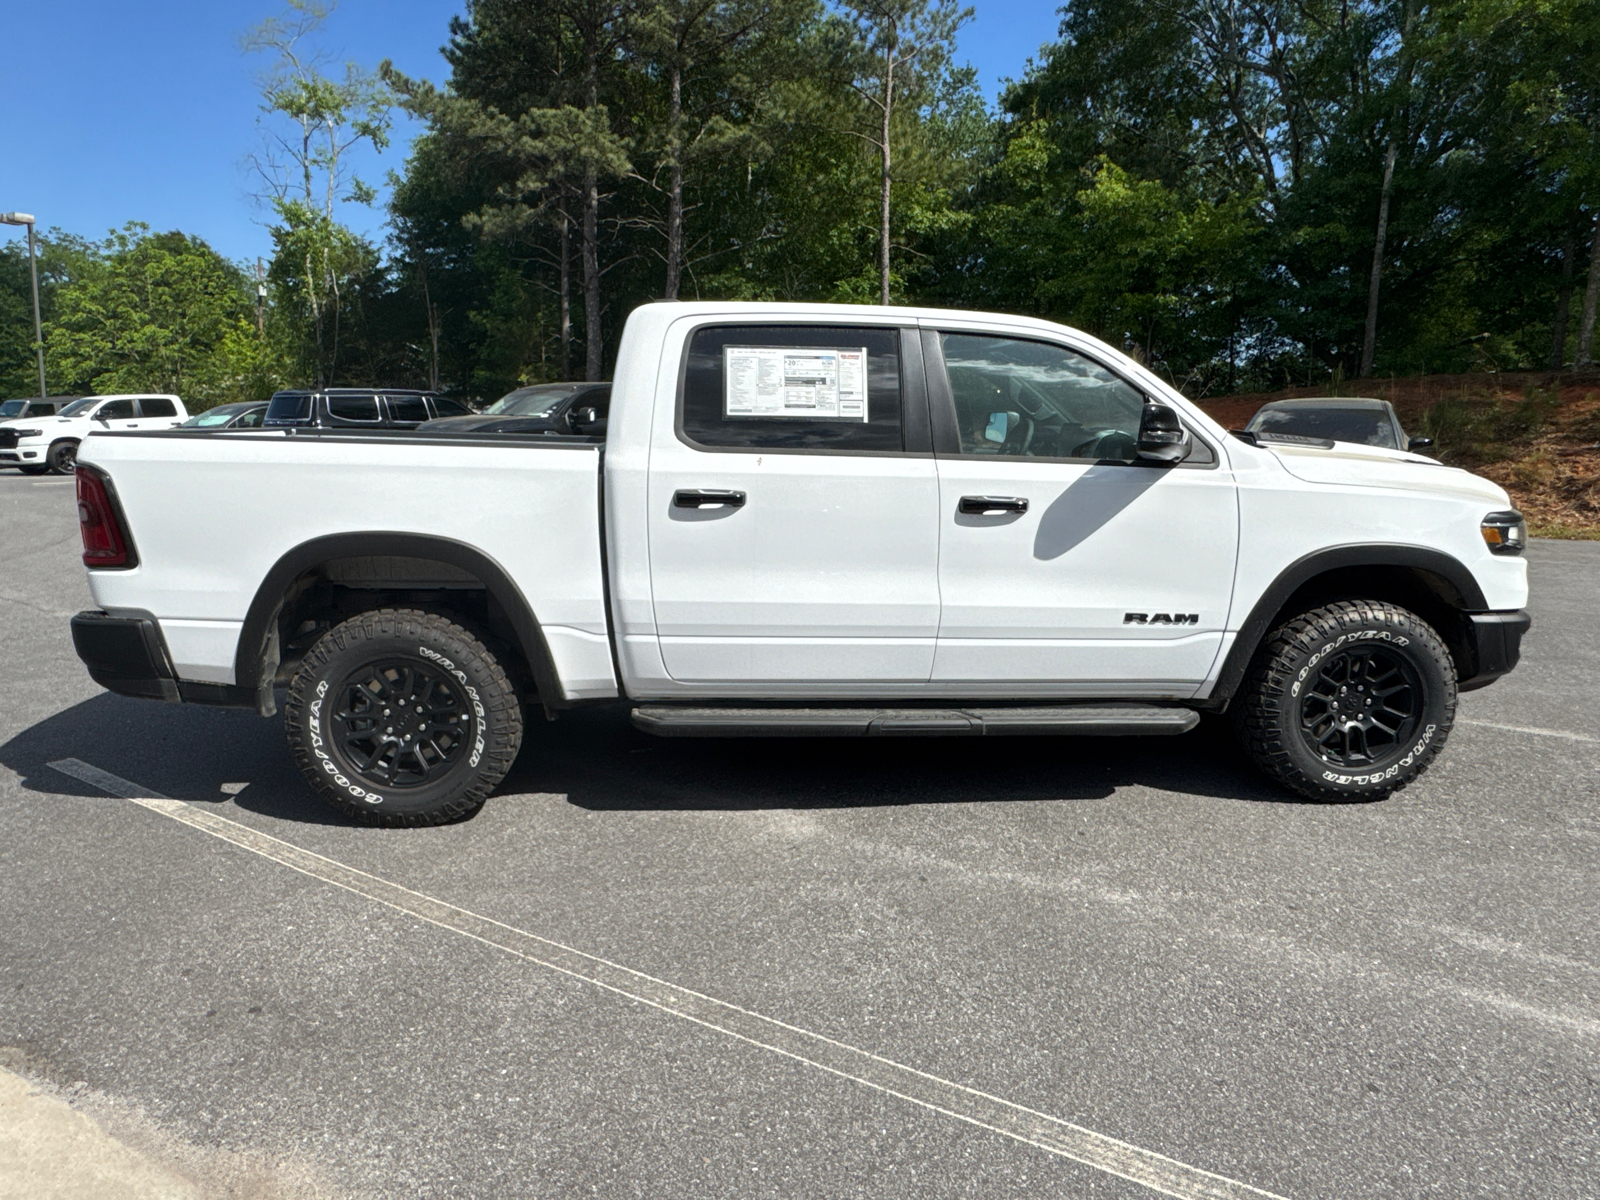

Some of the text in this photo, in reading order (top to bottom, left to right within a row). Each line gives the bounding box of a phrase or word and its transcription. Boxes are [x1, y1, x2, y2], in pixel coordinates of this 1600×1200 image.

[1122, 612, 1199, 625] RAM
[1291, 630, 1409, 697] GOODYEAR
[419, 646, 486, 768] WRANGLER
[308, 680, 383, 804] GOODYEAR
[1322, 724, 1436, 785] WRANGLER
